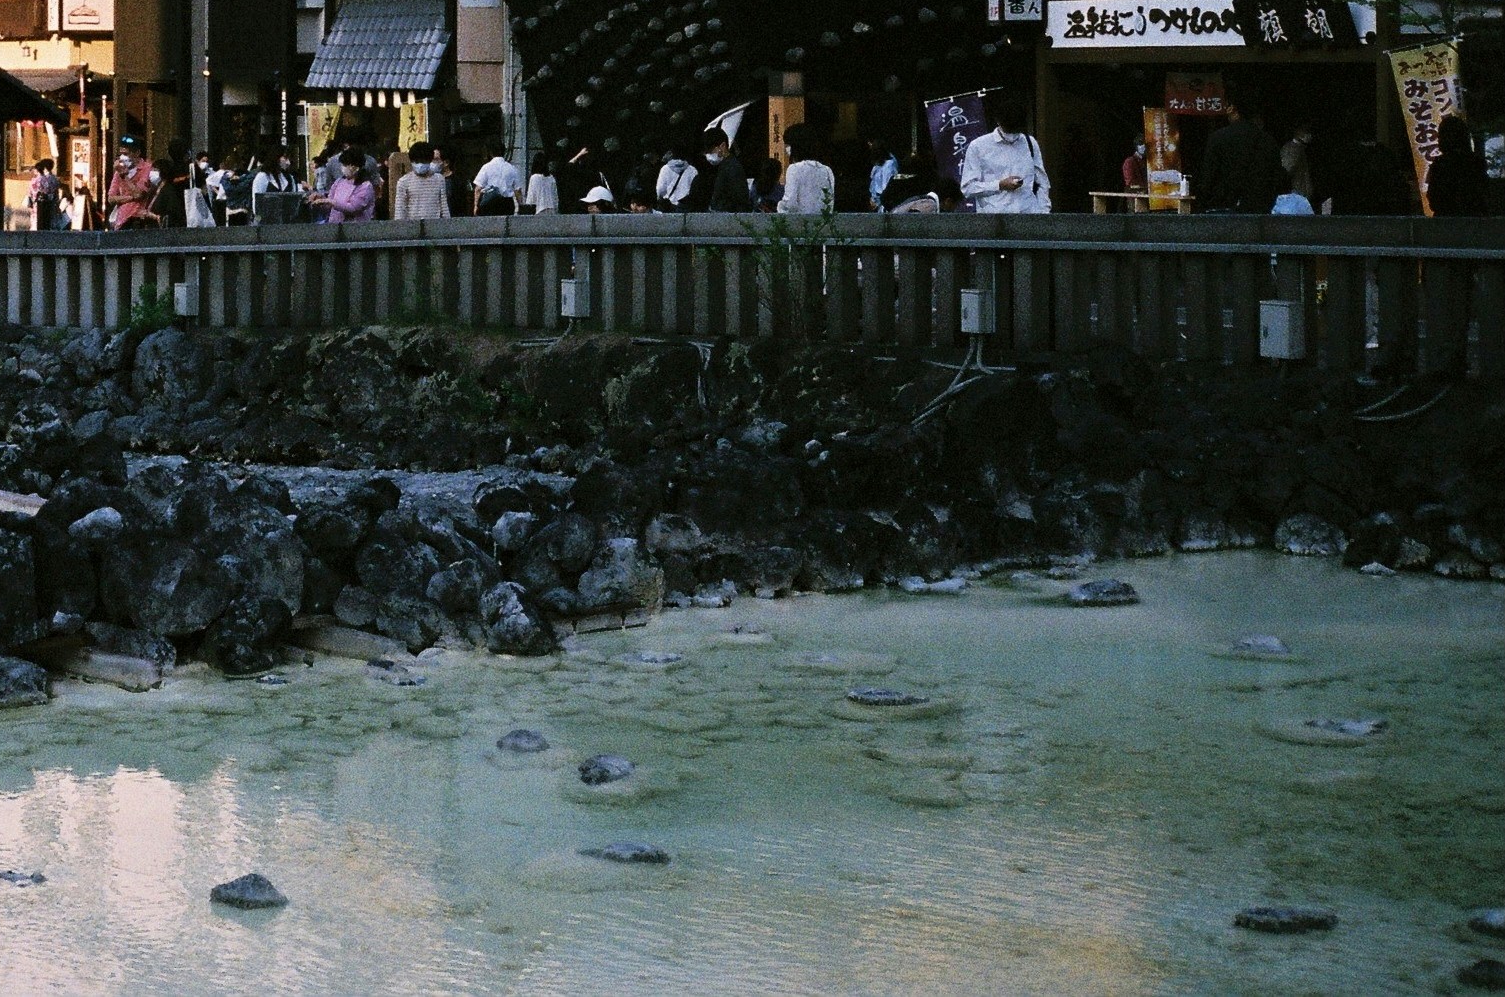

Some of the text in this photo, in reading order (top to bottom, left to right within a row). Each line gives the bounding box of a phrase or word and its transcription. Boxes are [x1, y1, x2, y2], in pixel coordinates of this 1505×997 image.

[1404, 78, 1442, 163] みそおで
[1431, 78, 1454, 113] コン
[939, 105, 980, 176] 温泉
